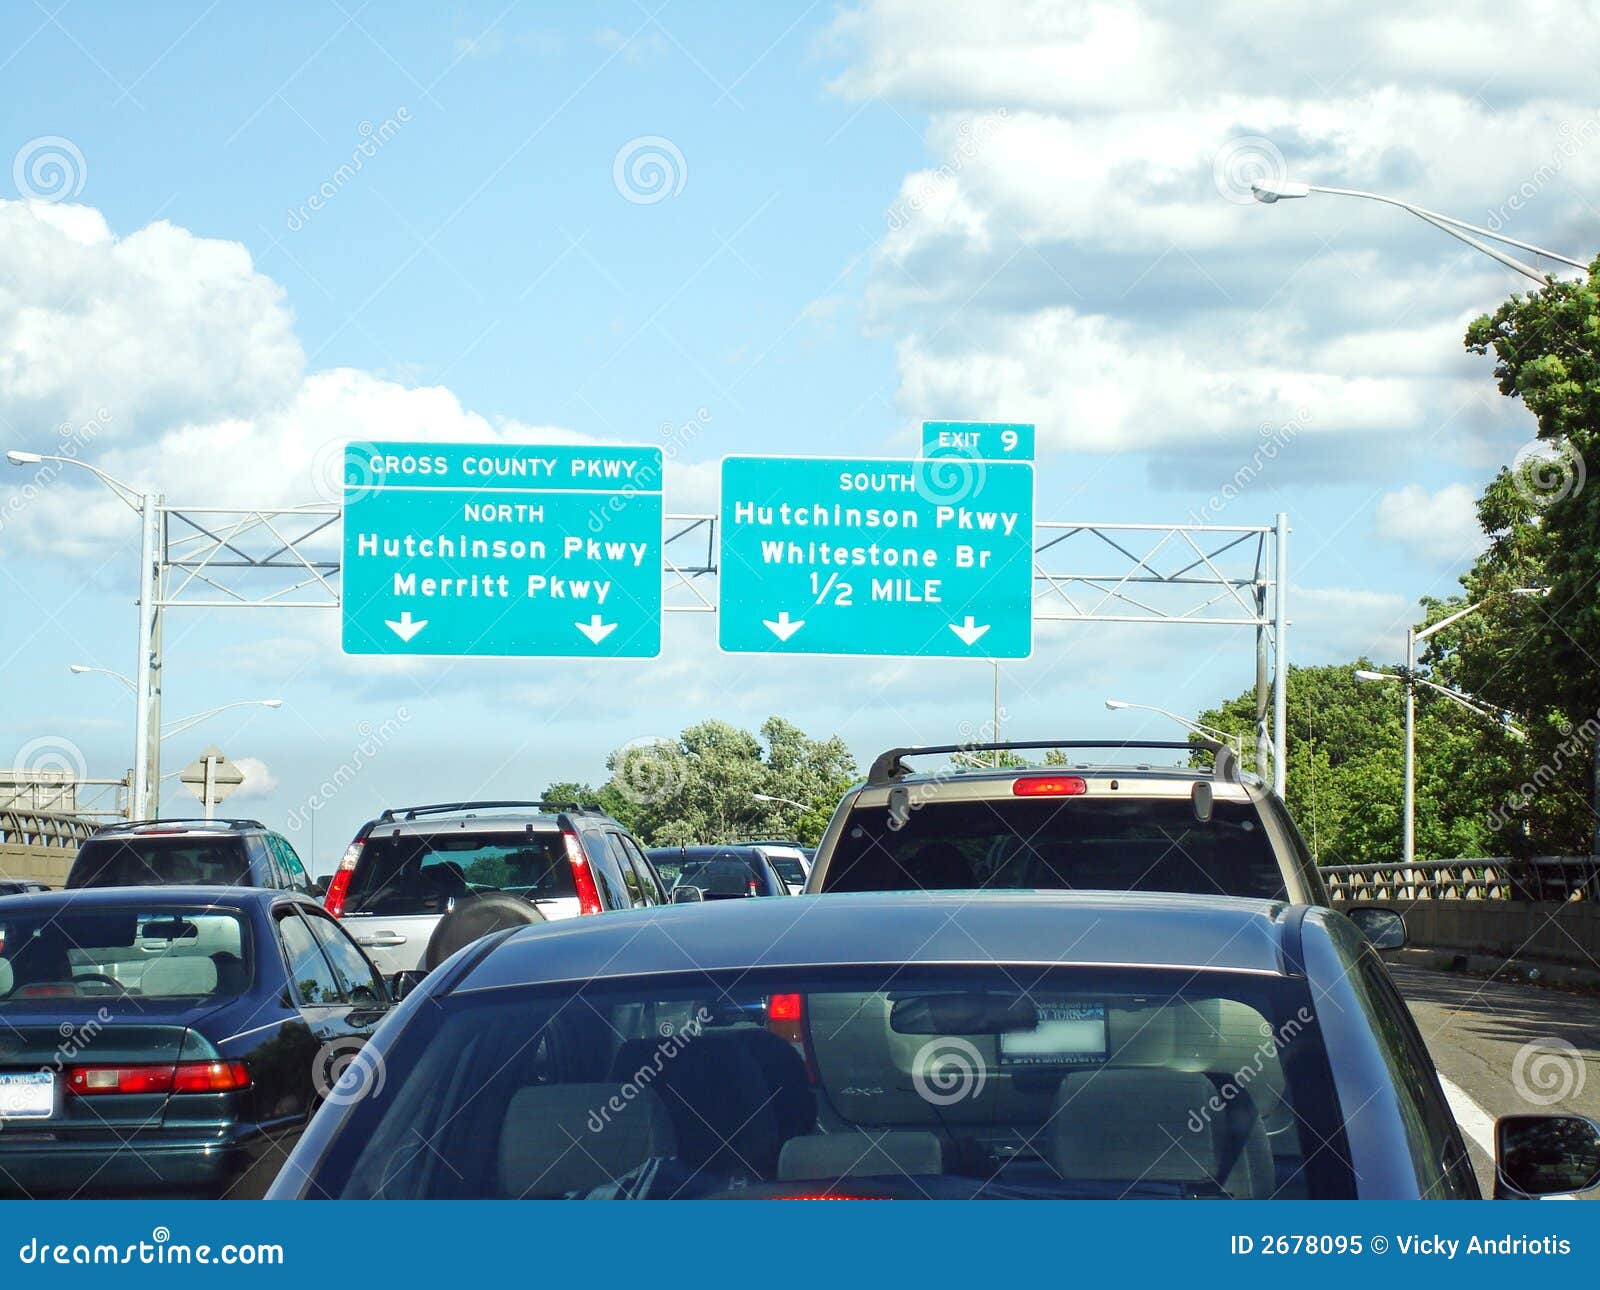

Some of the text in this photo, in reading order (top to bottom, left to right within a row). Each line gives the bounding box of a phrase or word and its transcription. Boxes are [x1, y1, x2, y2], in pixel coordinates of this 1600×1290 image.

[938, 430, 1018, 452] EXIT 9
[369, 455, 637, 478] CROSS COUNTY PKWY
[839, 472, 916, 492] SOUTH
[464, 503, 544, 523] NORTH
[734, 501, 1018, 535] Hutchinson Pkwy
[358, 533, 648, 566] Hutchinson Pkwy
[761, 540, 991, 568] Whitestone Br
[393, 572, 611, 604] Merritt Pkwy
[871, 579, 942, 603] MILE
